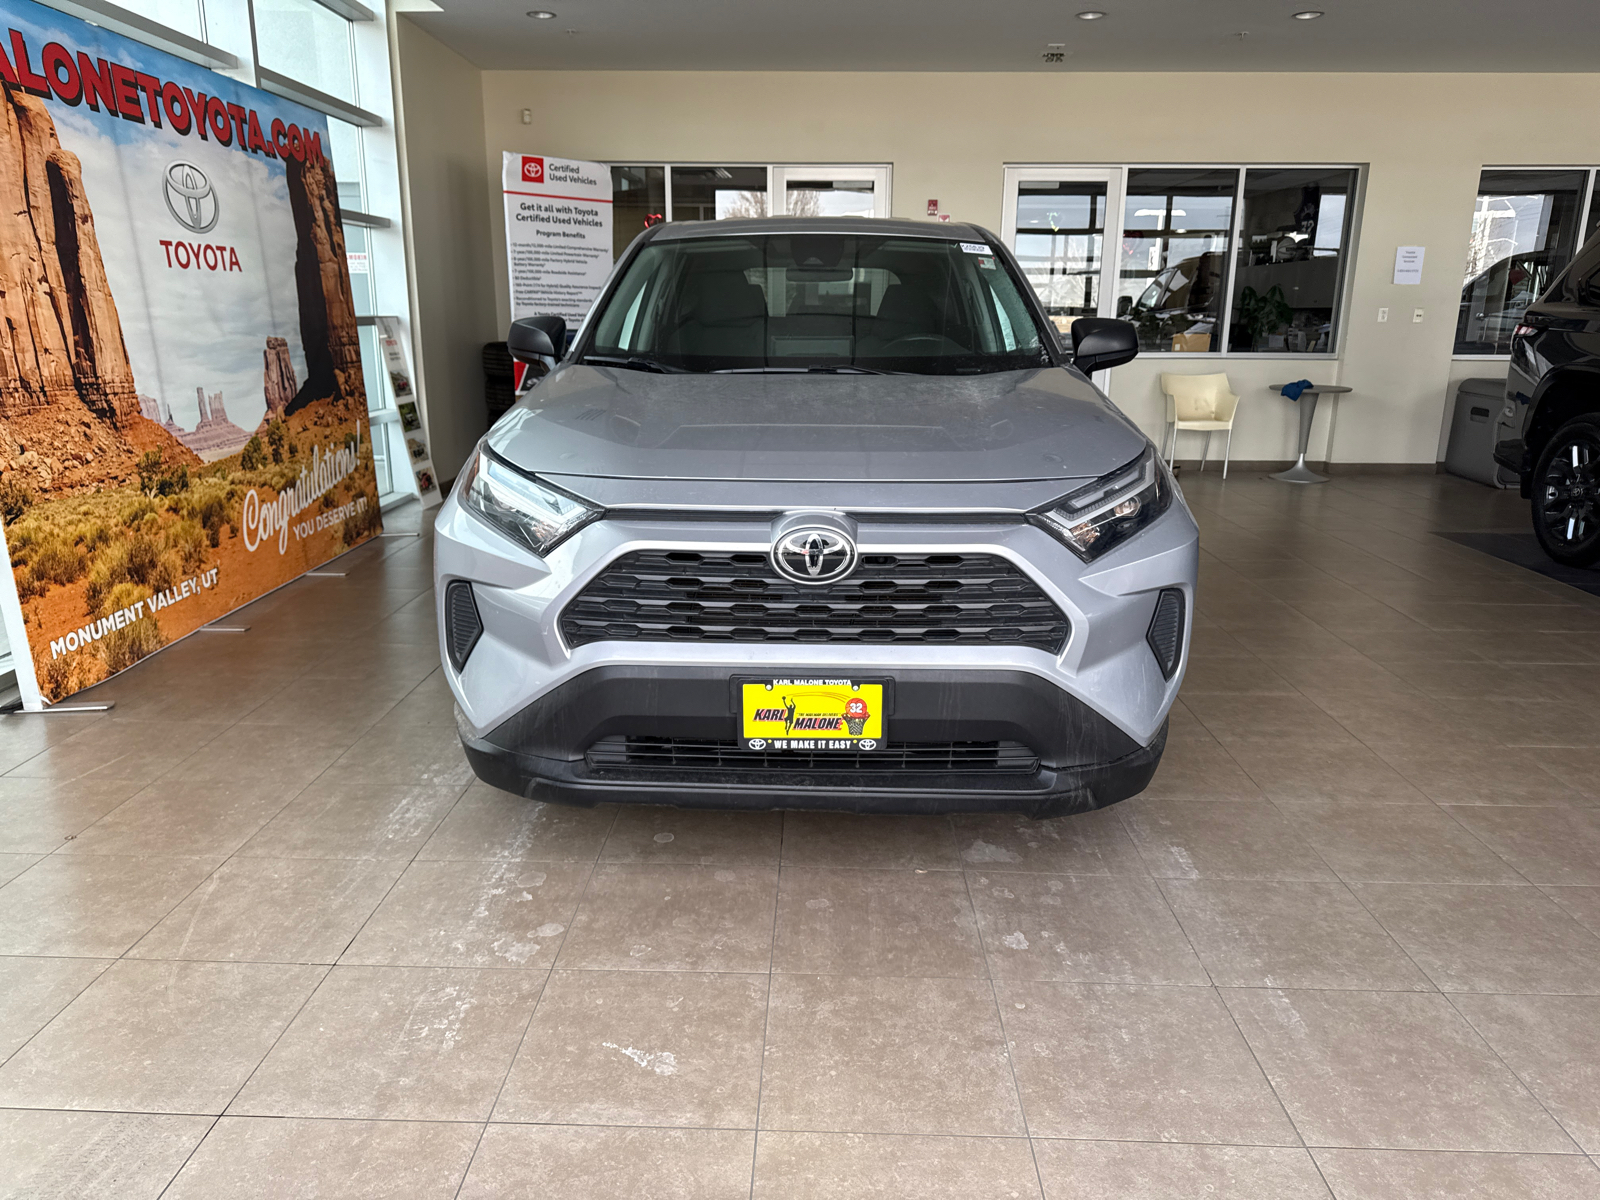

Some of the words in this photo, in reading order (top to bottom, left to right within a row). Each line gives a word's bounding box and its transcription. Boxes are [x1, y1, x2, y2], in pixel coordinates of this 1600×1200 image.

[549, 163, 579, 174] Certified
[549, 173, 567, 183] Used
[568, 176, 597, 186] Vehicles
[520, 203, 535, 211] Get
[536, 204, 542, 212] it
[544, 205, 554, 213] all
[555, 206, 572, 214] with
[574, 207, 598, 217] Toyota
[516, 213, 550, 224] Certified
[552, 216, 572, 225] Used
[572, 218, 603, 227] Vehicles
[536, 230, 562, 239] Program
[159, 240, 243, 272] TOYOTA
[243, 419, 360, 555] Congratulations!
[293, 518, 315, 541] YOU
[316, 503, 356, 531] DESERVE
[357, 496, 368, 514] IT!
[50, 601, 144, 660] MONUMENT
[147, 576, 201, 614] VALLEY,
[201, 568, 218, 588] UT
[850, 702, 863, 713] 32
[753, 709, 787, 722] KARL
[793, 718, 842, 730] MALONE
[774, 740, 790, 749] WE
[790, 740, 816, 749] MAKE
[818, 740, 826, 749] IT
[829, 740, 852, 750] EASY
